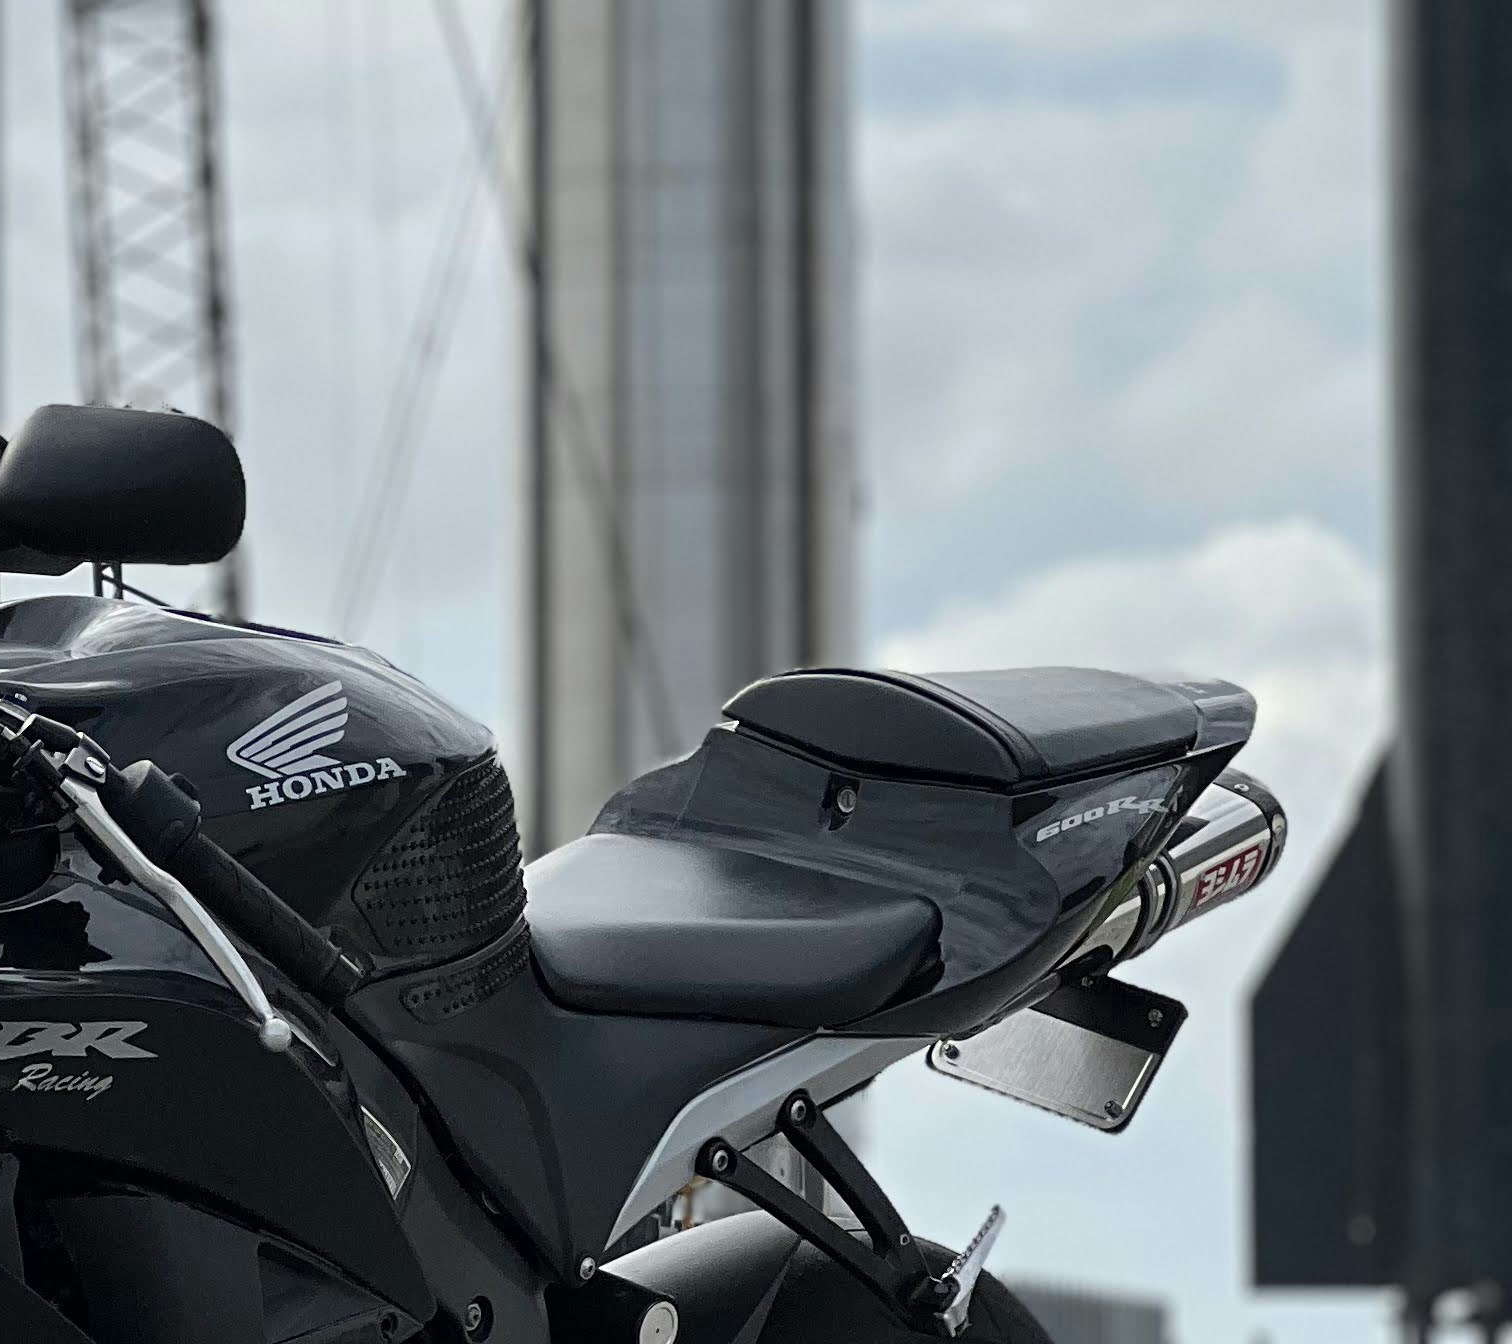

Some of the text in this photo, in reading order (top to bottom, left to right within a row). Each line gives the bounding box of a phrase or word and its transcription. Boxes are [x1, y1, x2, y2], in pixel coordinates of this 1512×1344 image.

[245, 757, 407, 810] HONDA
[1036, 796, 1170, 844] 600RR
[1196, 849, 1259, 906] ヨシムラ
[11, 1063, 113, 1101] Racing
